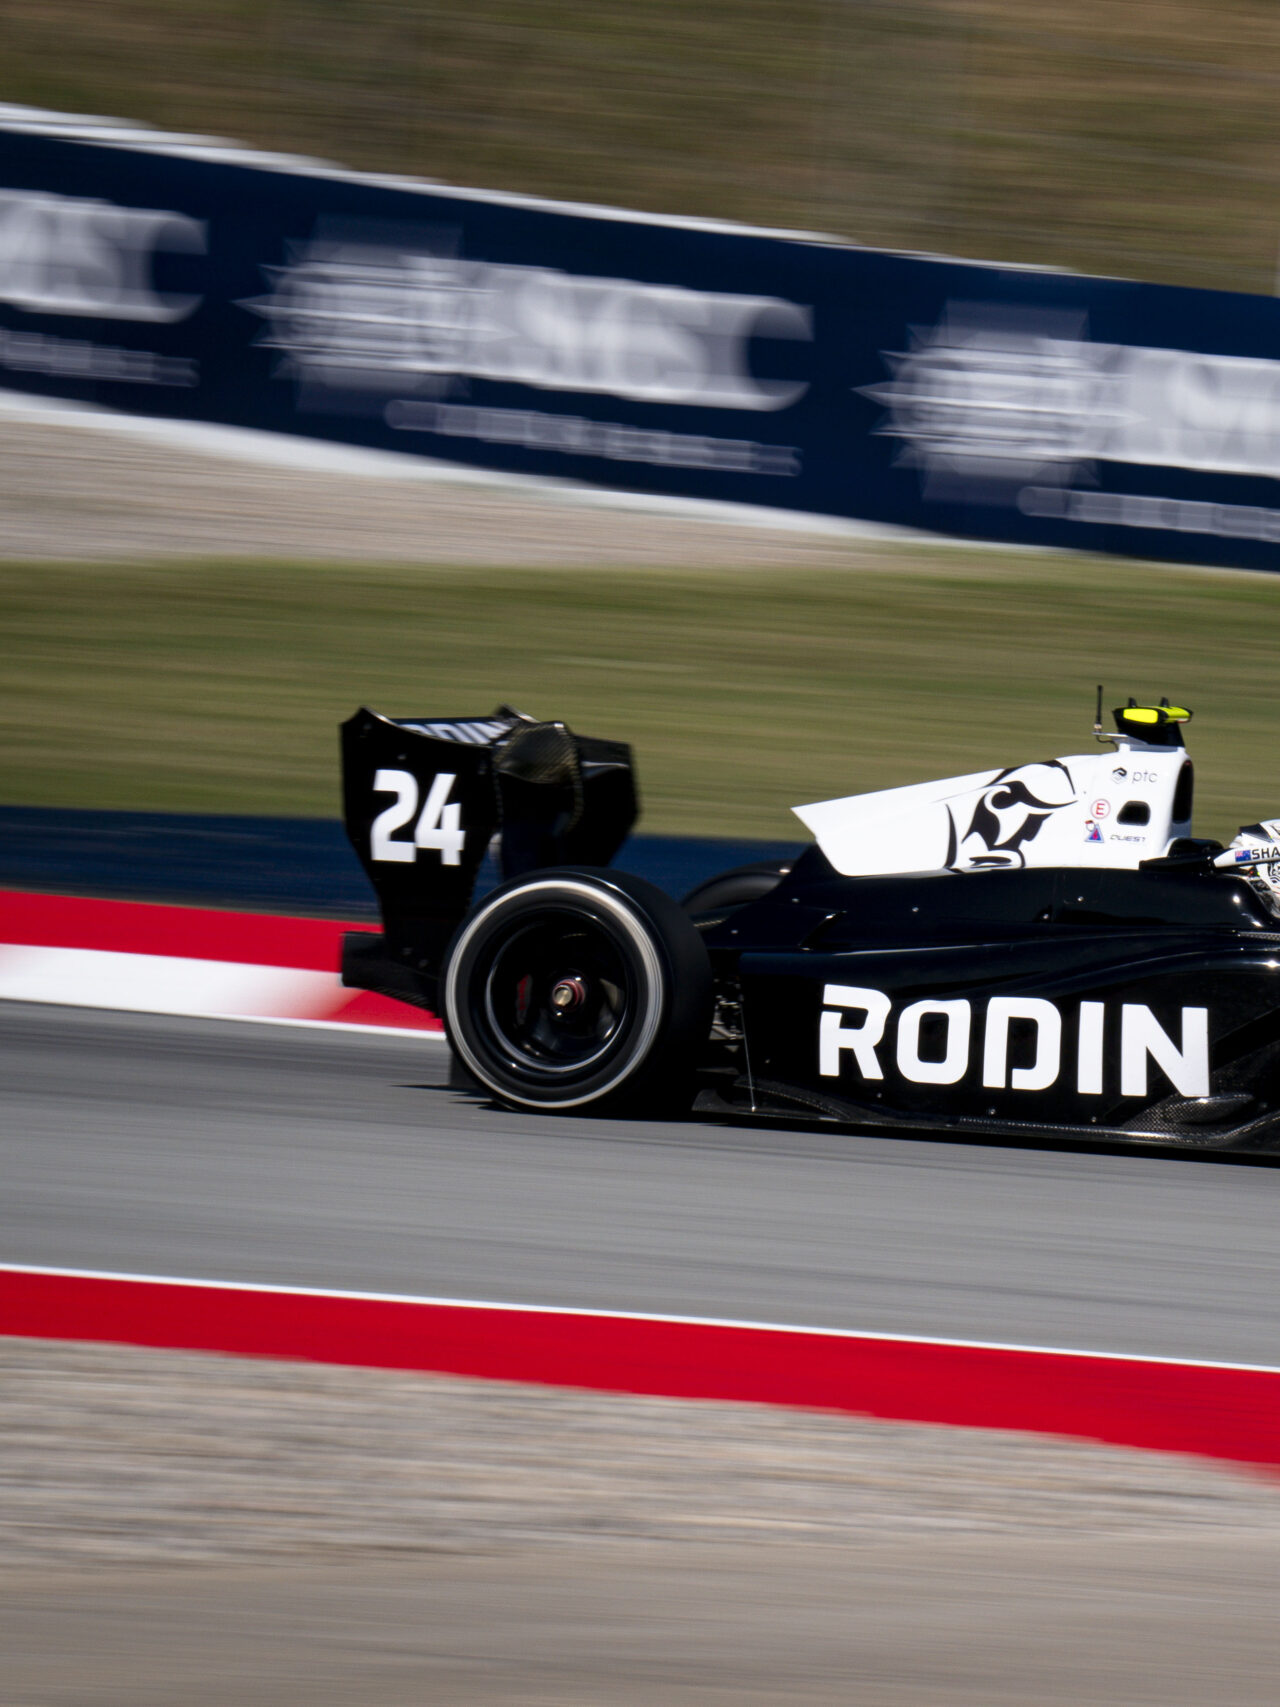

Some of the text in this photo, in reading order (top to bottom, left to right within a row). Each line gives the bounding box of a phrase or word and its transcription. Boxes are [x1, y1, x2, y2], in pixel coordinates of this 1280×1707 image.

[370, 769, 466, 866] 24
[1132, 769, 1158, 784] ptc
[819, 983, 1211, 1097] RODIN
